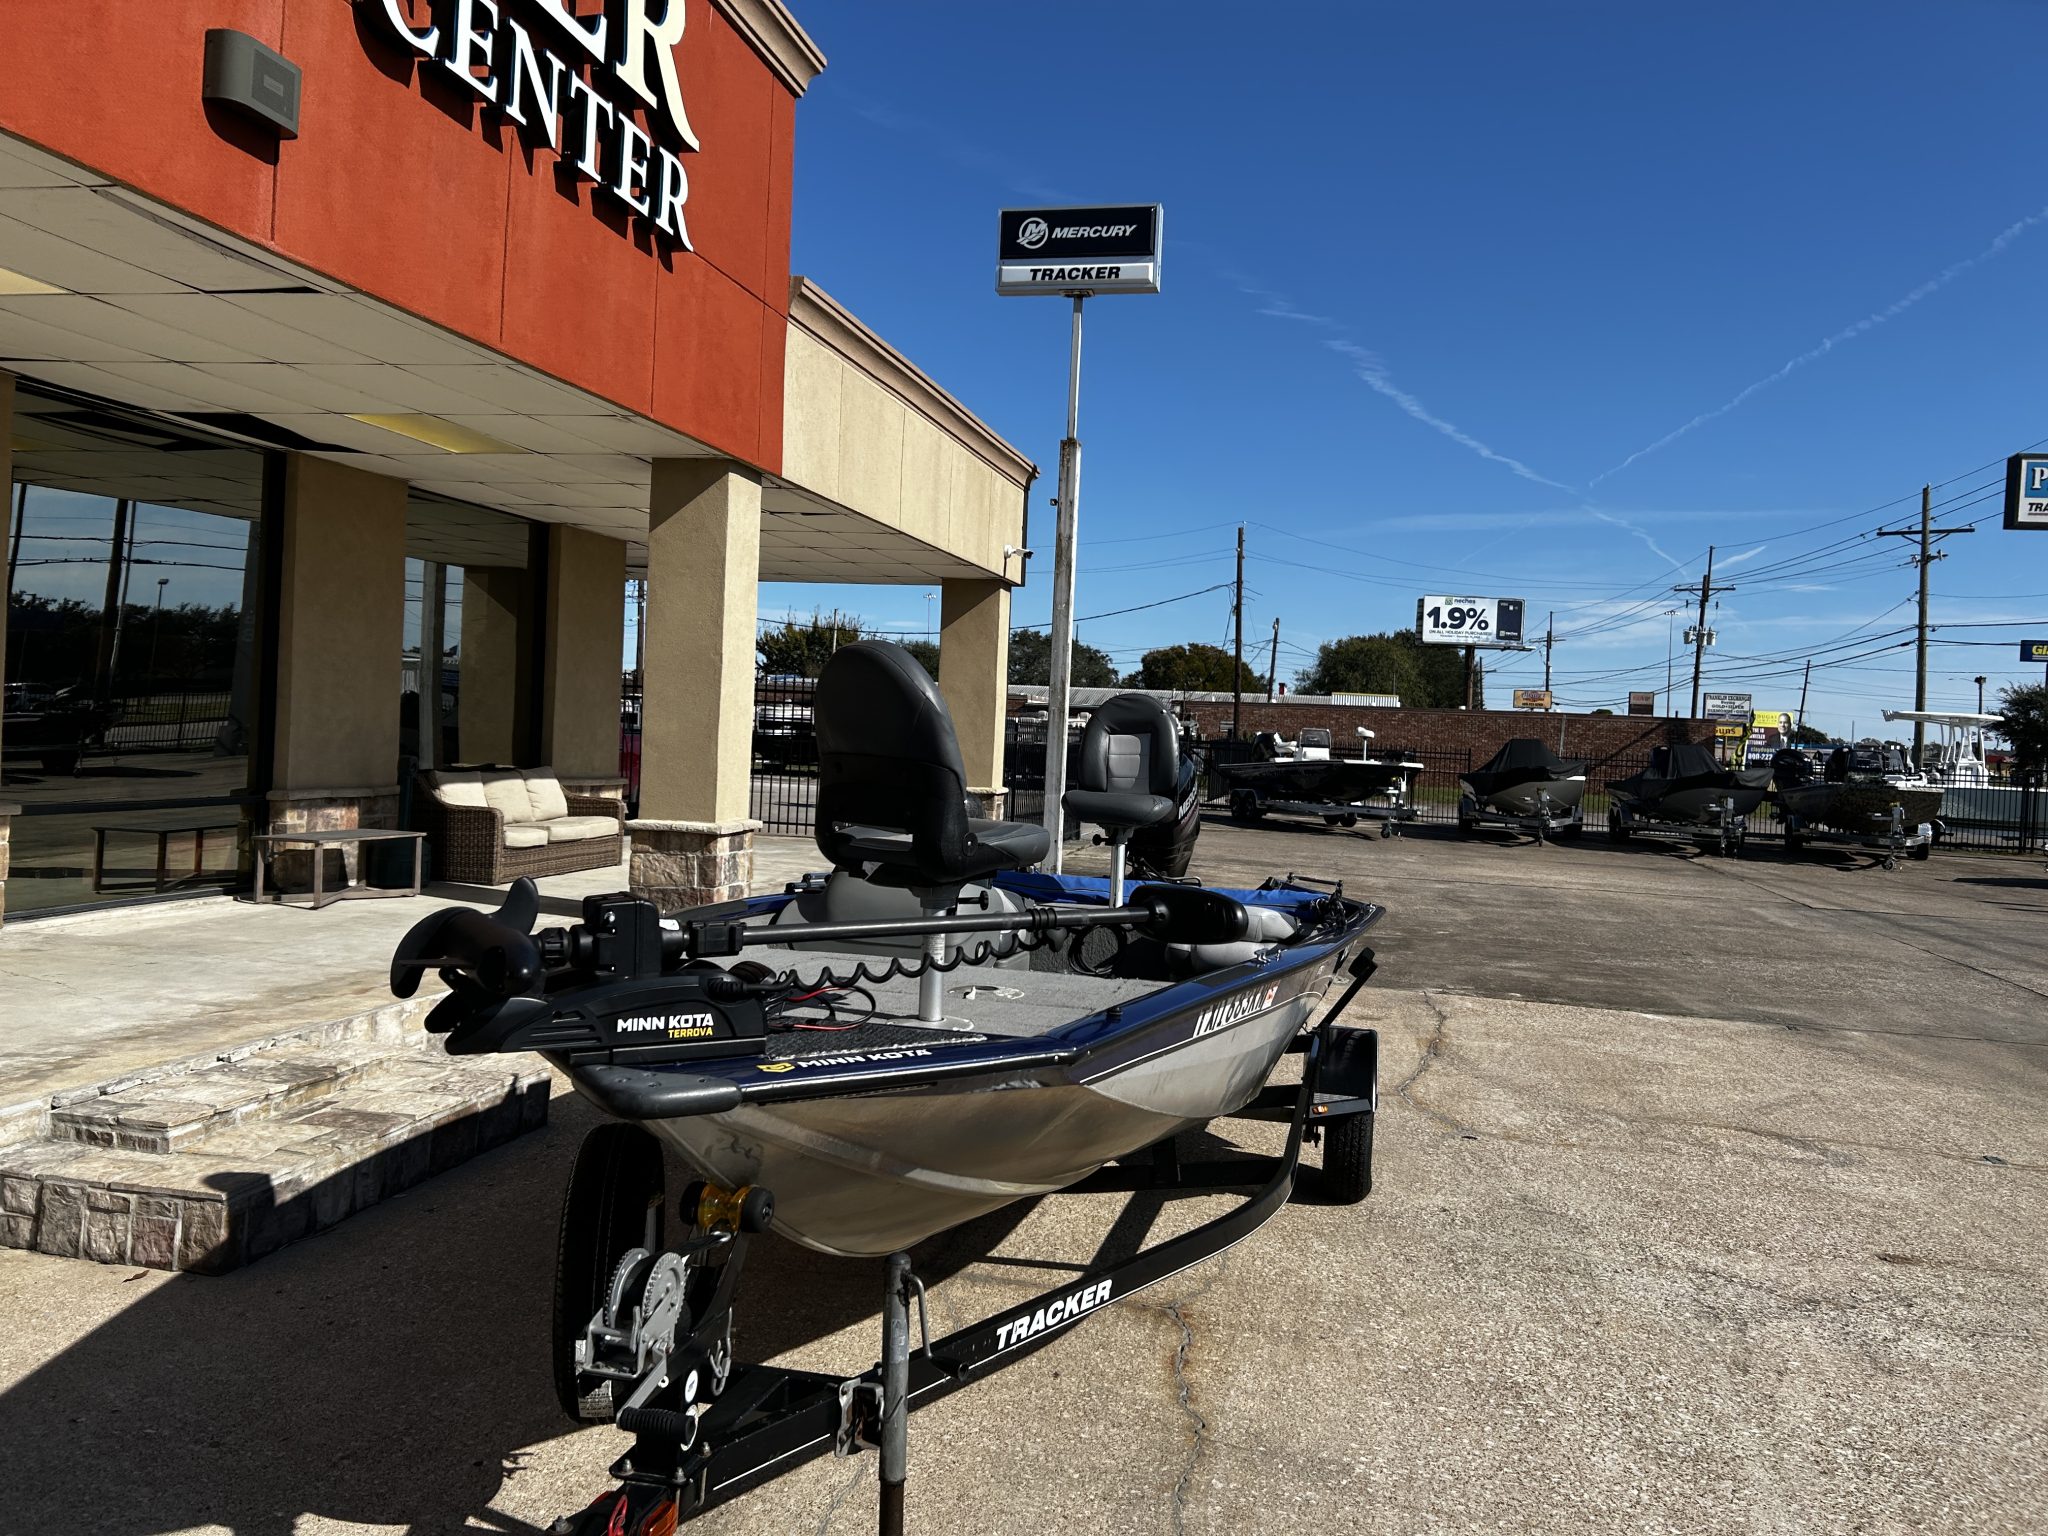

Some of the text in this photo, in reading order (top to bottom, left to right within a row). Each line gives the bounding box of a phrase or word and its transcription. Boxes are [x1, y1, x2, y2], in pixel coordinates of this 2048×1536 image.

[1051, 224, 1137, 239] MERCURY
[1029, 266, 1121, 281] TRACKER
[1427, 606, 1489, 631] 1.9%
[617, 1013, 714, 1032] MINN KOTA
[668, 1027, 713, 1039] TERROVA
[797, 1049, 933, 1068] MINN KOTA
[996, 1279, 1113, 1350] TRACKER
